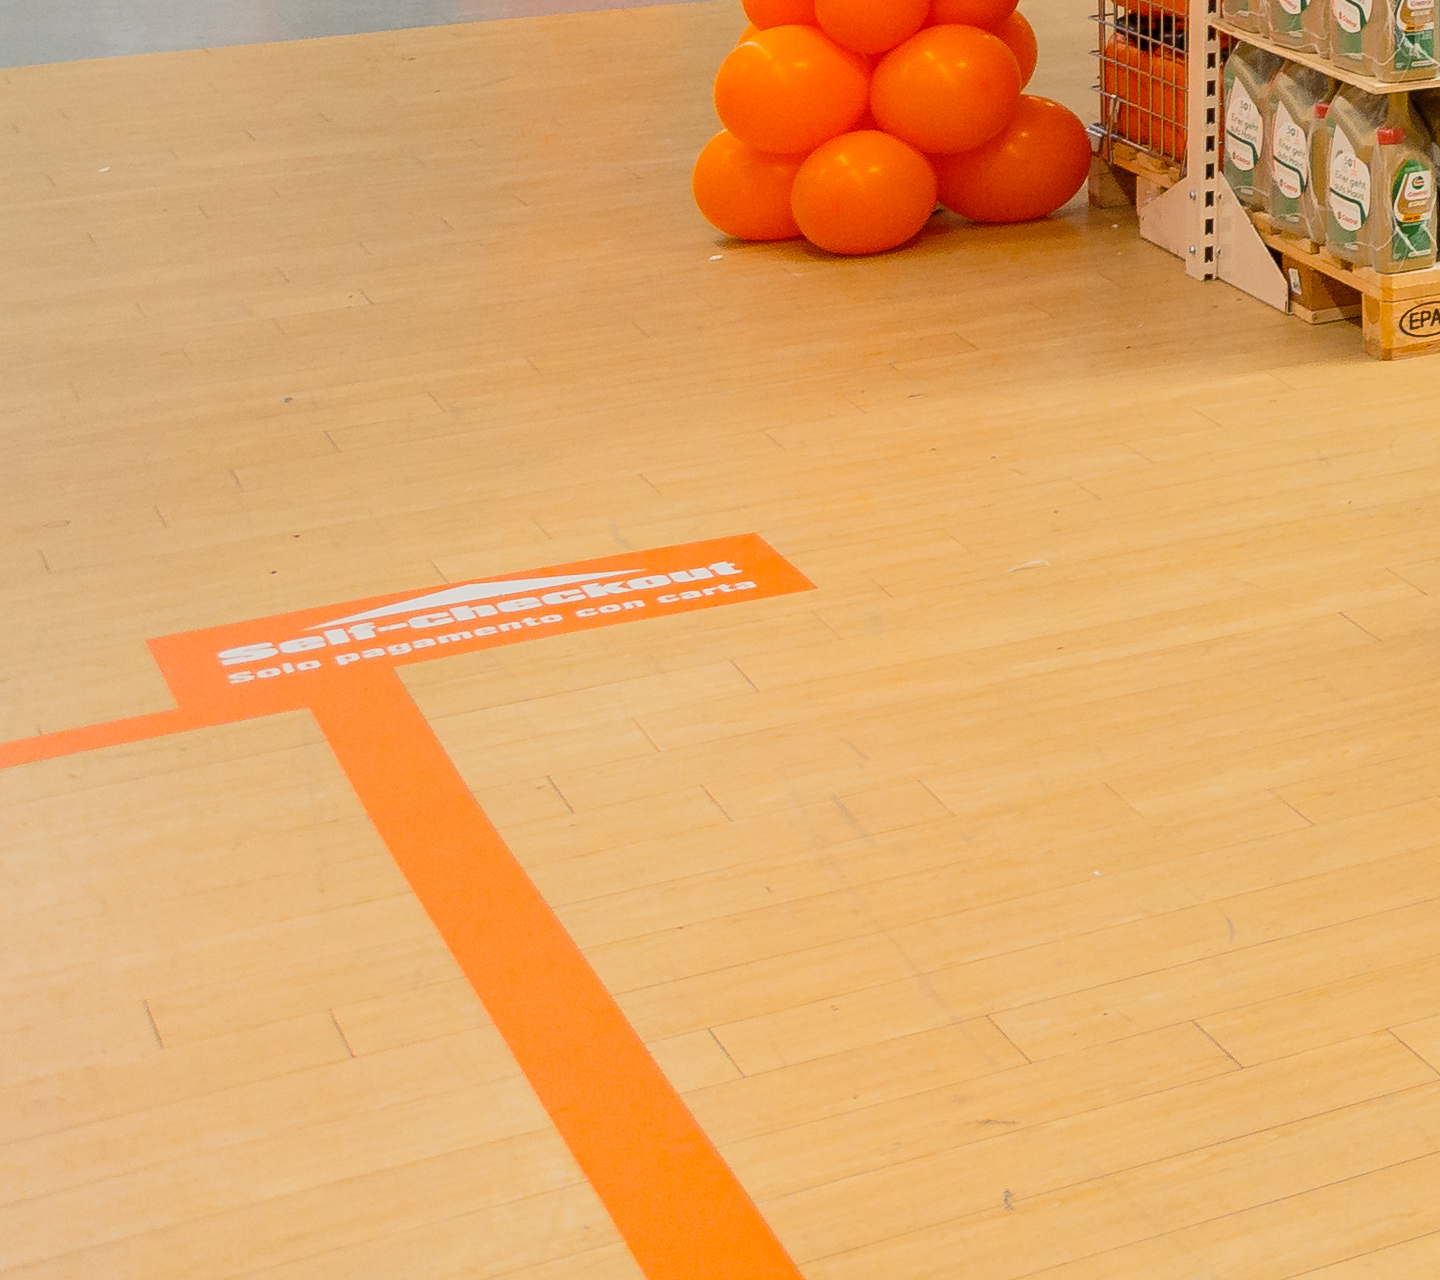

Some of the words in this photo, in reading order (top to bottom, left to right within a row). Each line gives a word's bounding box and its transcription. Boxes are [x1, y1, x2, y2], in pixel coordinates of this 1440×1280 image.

[217, 559, 744, 666] Self-checkout
[227, 660, 323, 685] Solo
[335, 610, 567, 669] pagamento
[576, 598, 648, 619] con
[658, 580, 759, 605] carta
